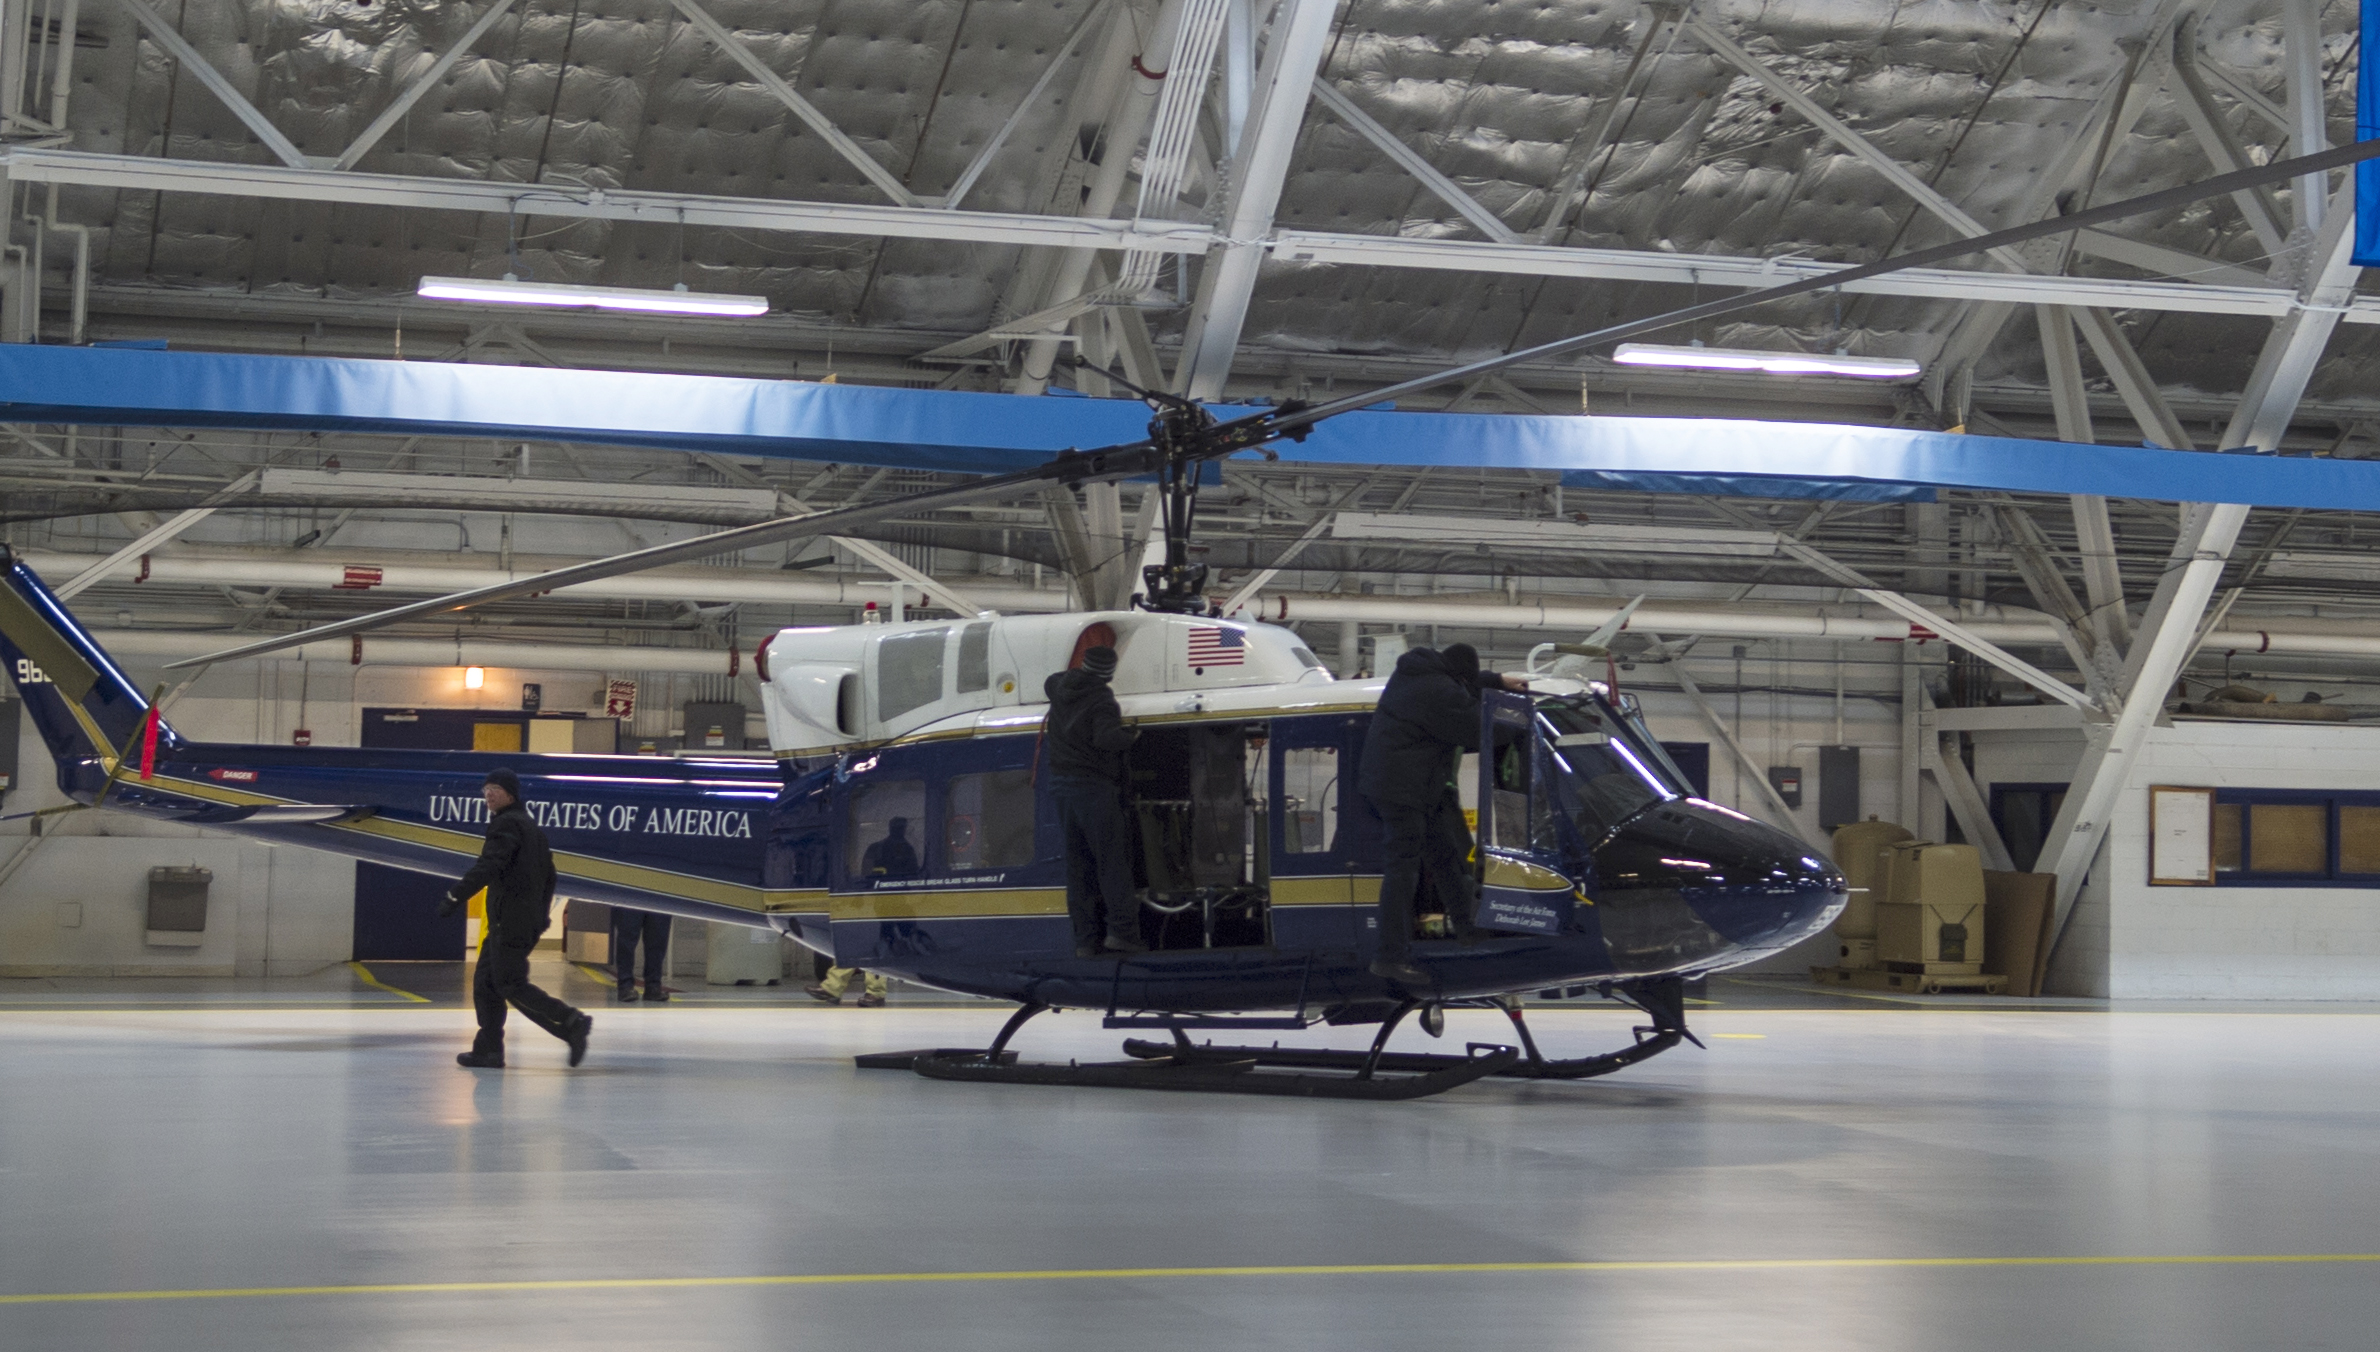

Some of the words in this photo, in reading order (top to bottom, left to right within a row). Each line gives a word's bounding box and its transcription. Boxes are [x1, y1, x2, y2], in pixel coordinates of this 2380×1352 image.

[17, 659, 52, 683] 96
[222, 770, 252, 780] DANGER
[609, 804, 639, 832] OF
[643, 807, 753, 839] AMERICA
